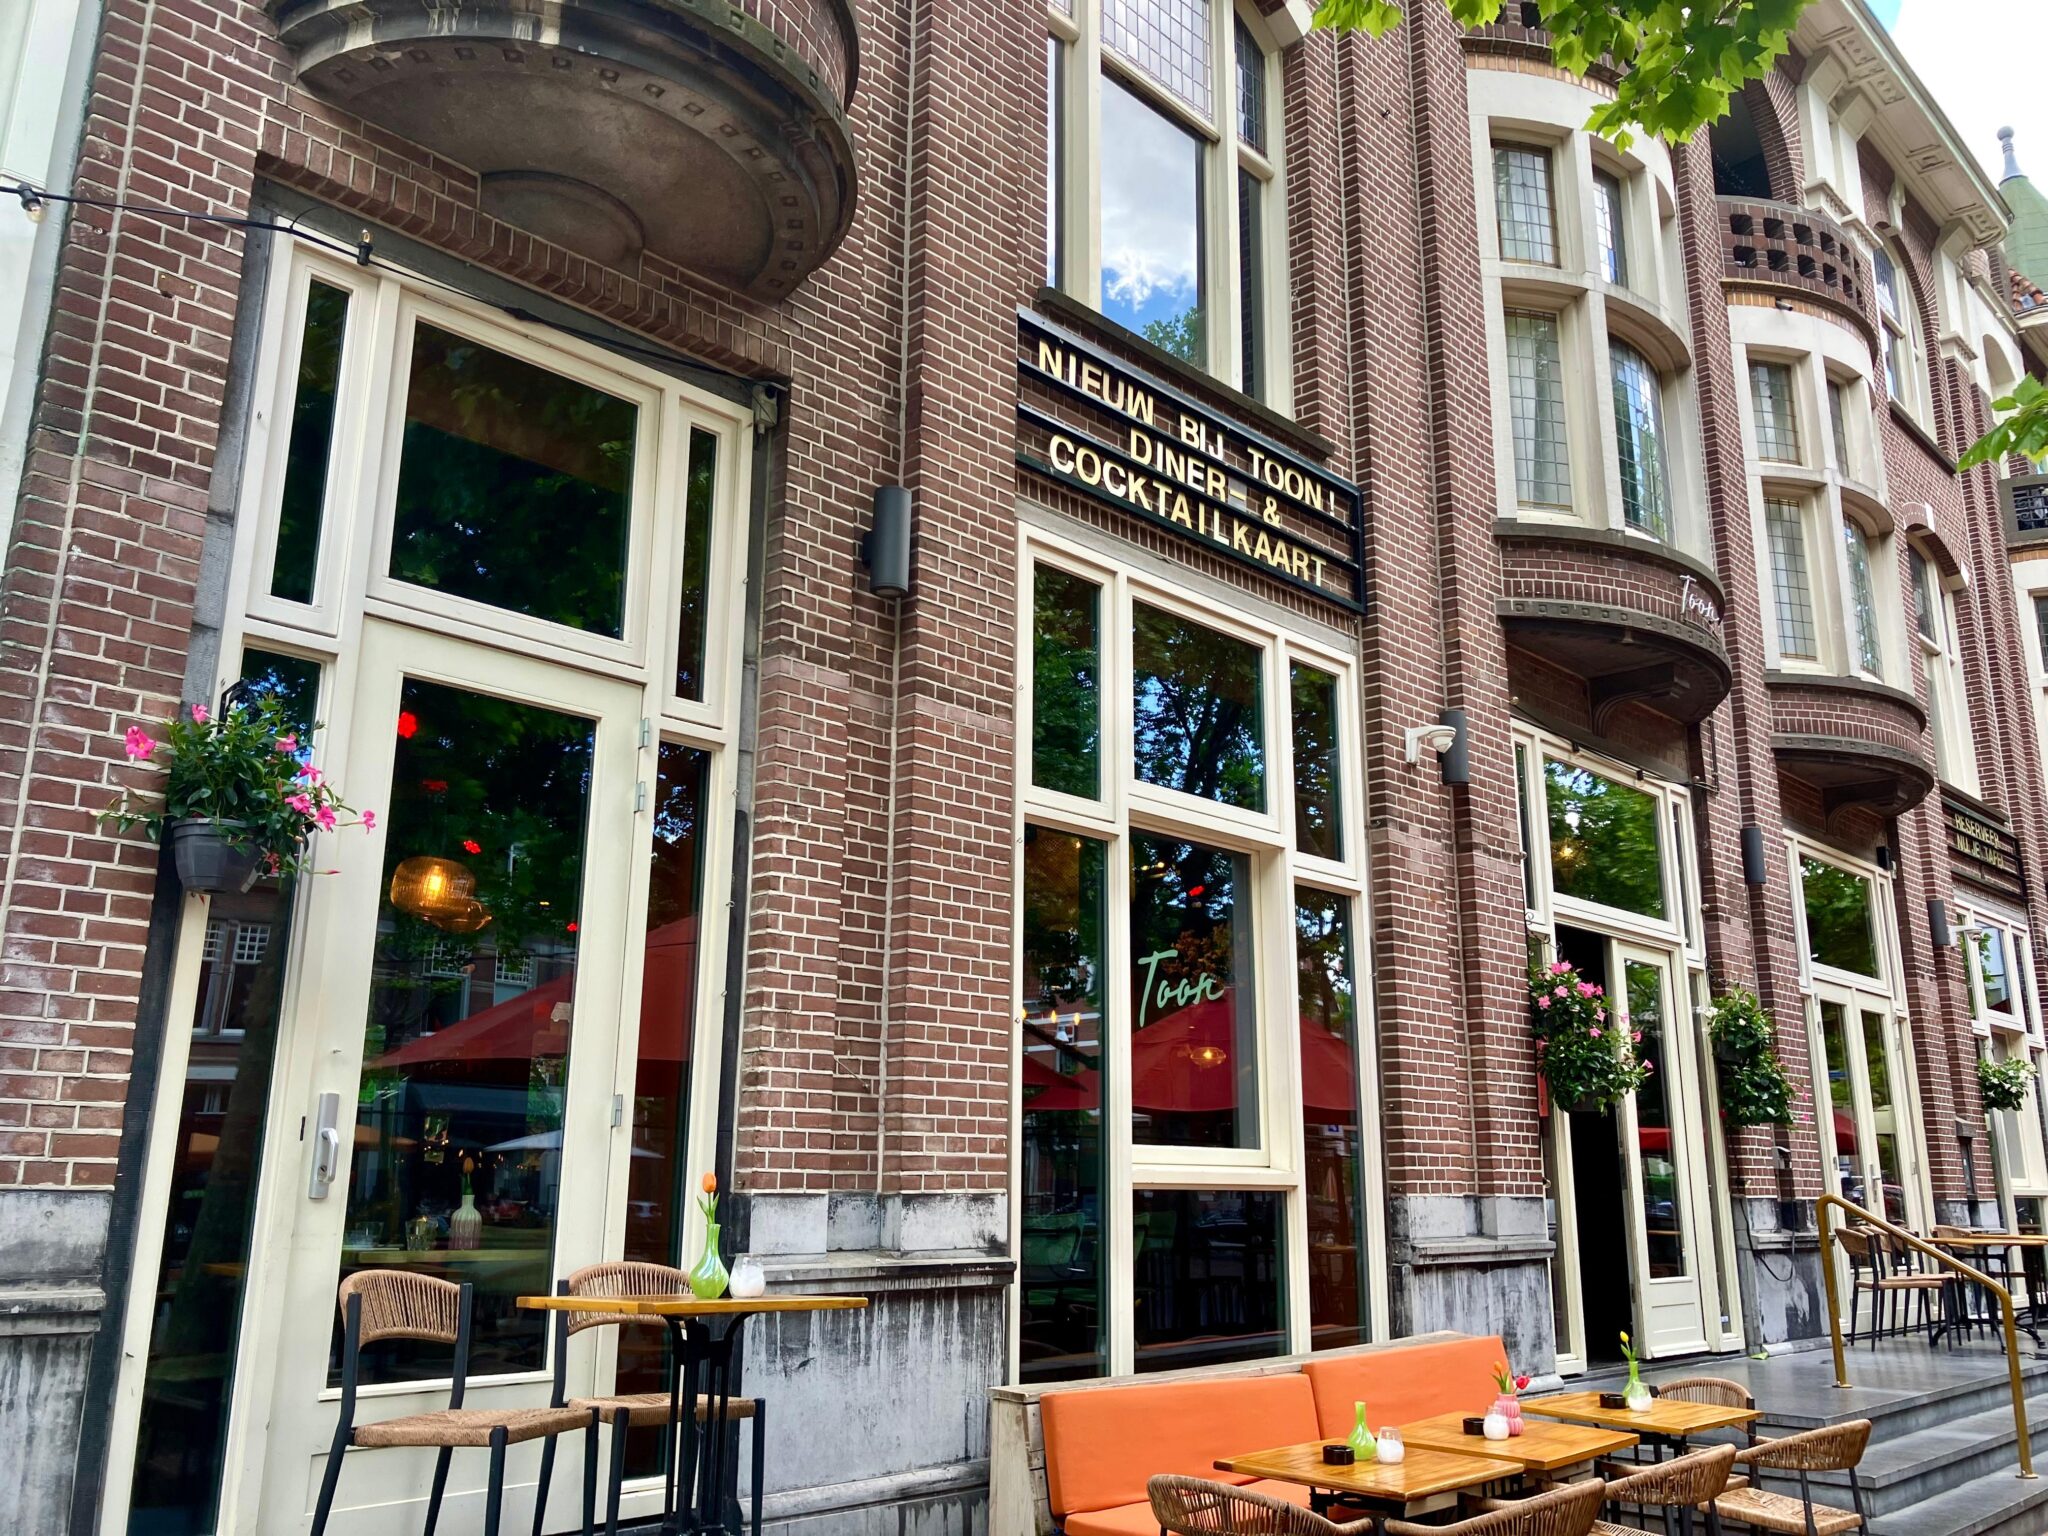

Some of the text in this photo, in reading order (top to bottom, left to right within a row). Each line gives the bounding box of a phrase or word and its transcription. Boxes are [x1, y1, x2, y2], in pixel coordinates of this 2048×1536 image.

[1039, 338, 1154, 426] NIEUW
[1180, 412, 1224, 462] BIJ
[1050, 434, 1327, 587] COCKTAILKAART
[1263, 496, 1281, 529] &
[1679, 575, 1721, 621] Toon
[1955, 813, 1999, 849] RESERVEER
[1956, 832, 1969, 852] NU
[1971, 840, 1980, 858] JE
[1137, 949, 1225, 1028] Toon
